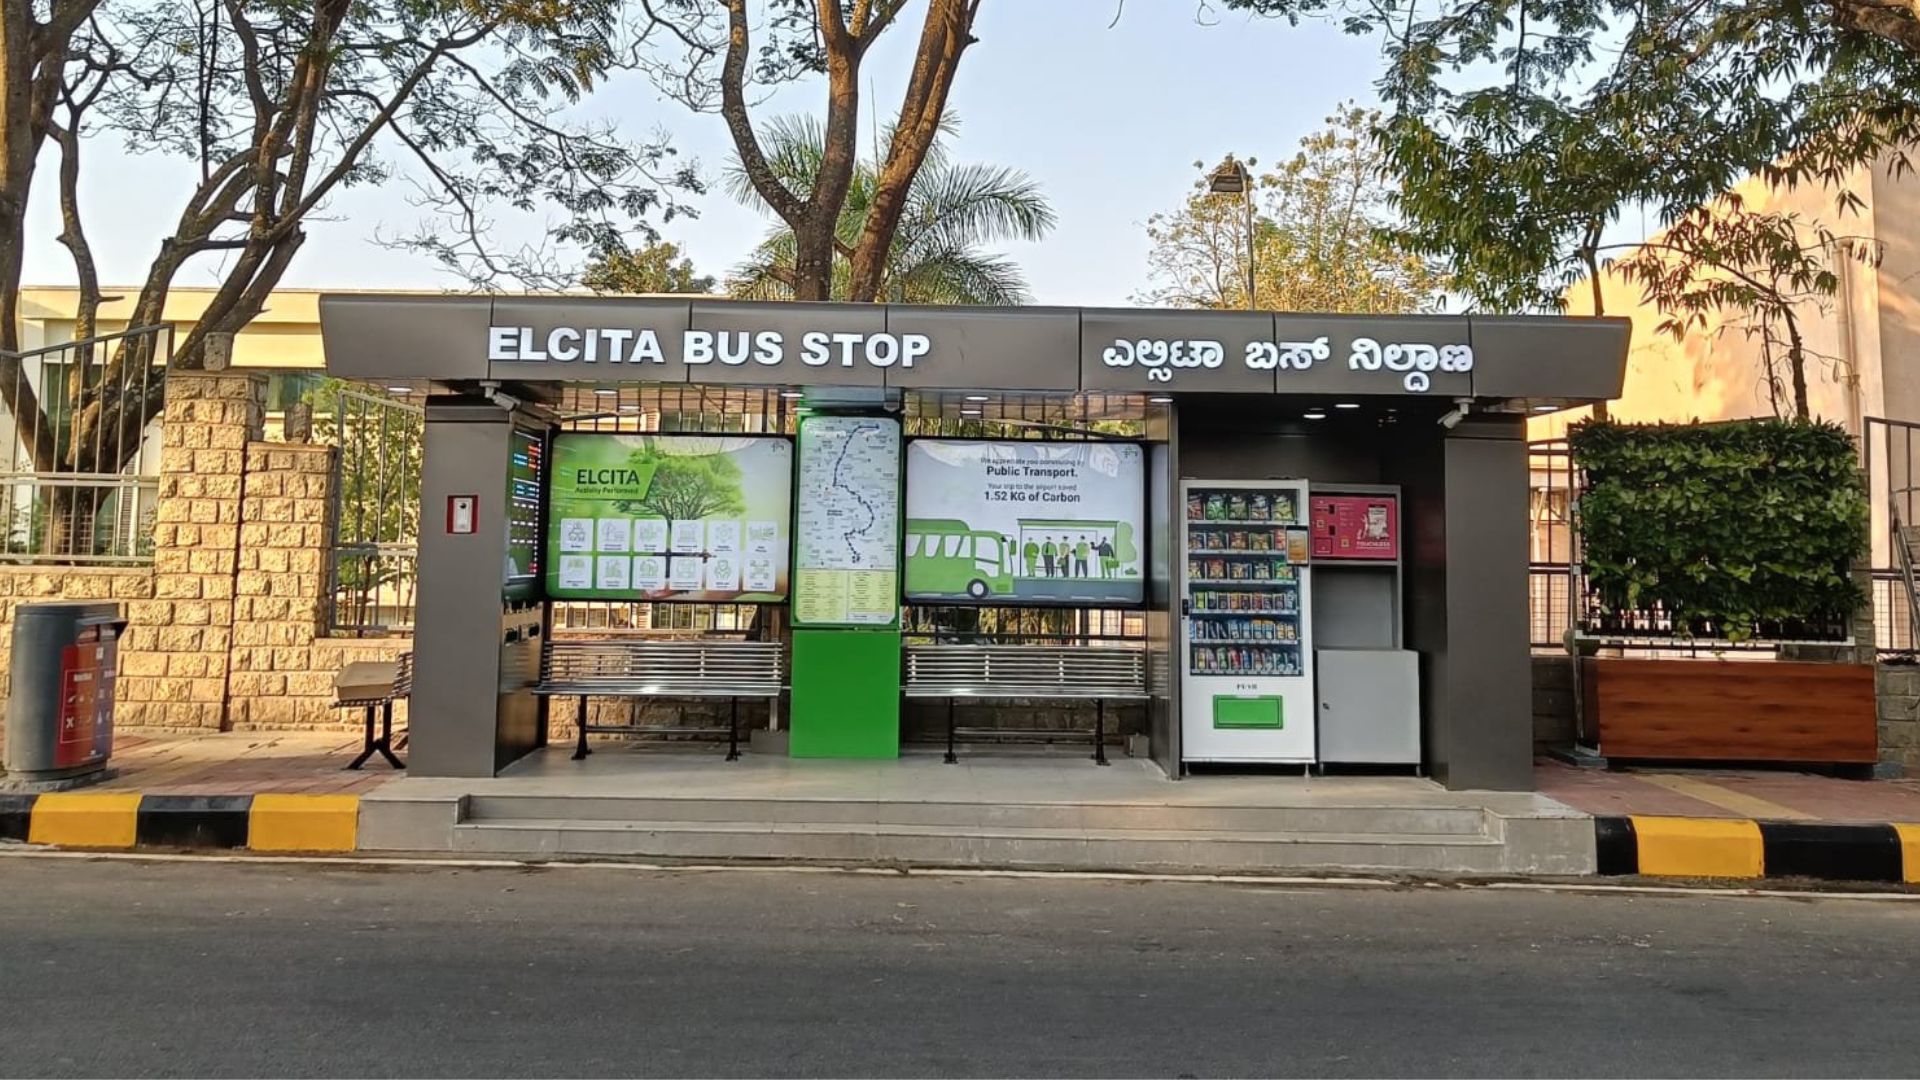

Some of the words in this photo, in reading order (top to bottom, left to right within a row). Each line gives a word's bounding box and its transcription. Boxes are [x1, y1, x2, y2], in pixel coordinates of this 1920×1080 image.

[489, 327, 666, 363] ELCITA
[683, 330, 784, 366] BUS
[800, 331, 930, 368] STOP
[1103, 339, 1224, 382] ಎಲ್ಸಿಟಾ
[1245, 337, 1330, 370] ಬಸ್
[1348, 337, 1474, 392] ನಿಲ್ದಾಣ
[577, 469, 640, 485] ELCITA
[986, 466, 1020, 476] Public
[1023, 466, 1078, 478] Transport.
[984, 491, 1008, 501] 1.52
[1010, 491, 1026, 501] KG
[1028, 491, 1040, 502] of
[1042, 492, 1080, 502] Carbon
